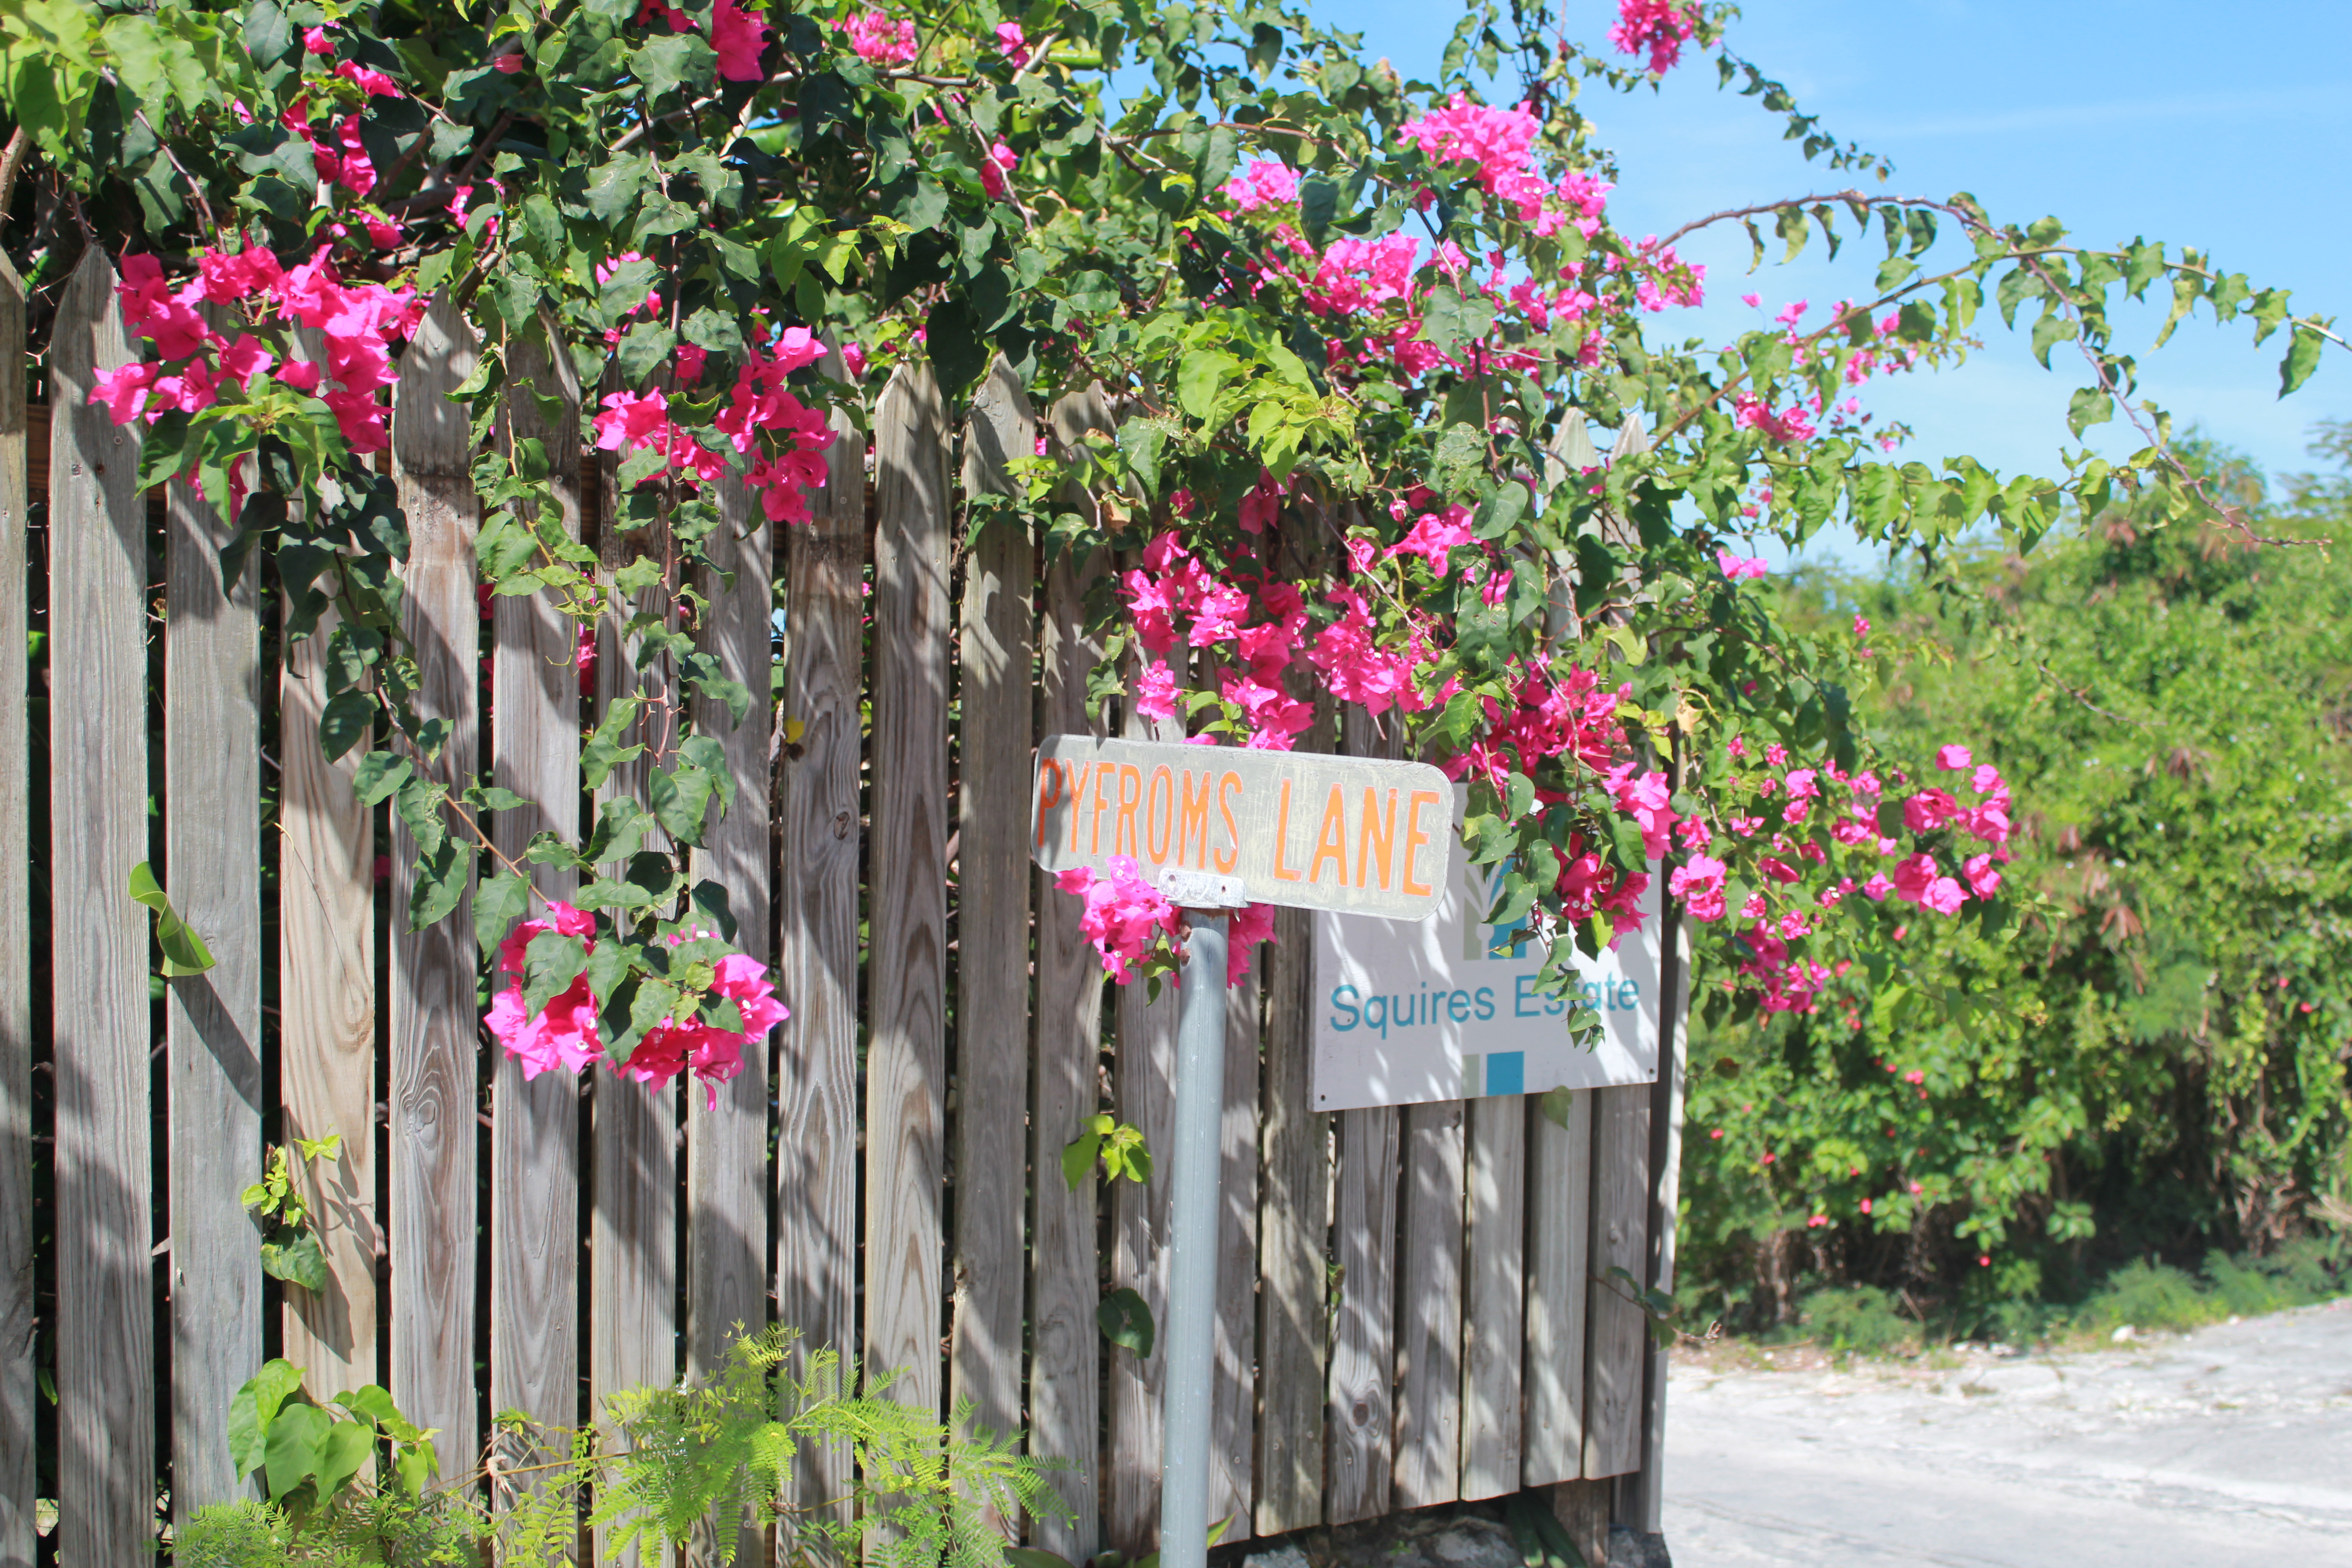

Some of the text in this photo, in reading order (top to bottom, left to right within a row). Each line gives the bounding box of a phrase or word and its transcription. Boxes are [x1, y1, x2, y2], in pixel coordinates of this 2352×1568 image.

[1037, 758, 1440, 897] PYFROMS LANE
[1330, 971, 1639, 1040] Squires Esate
